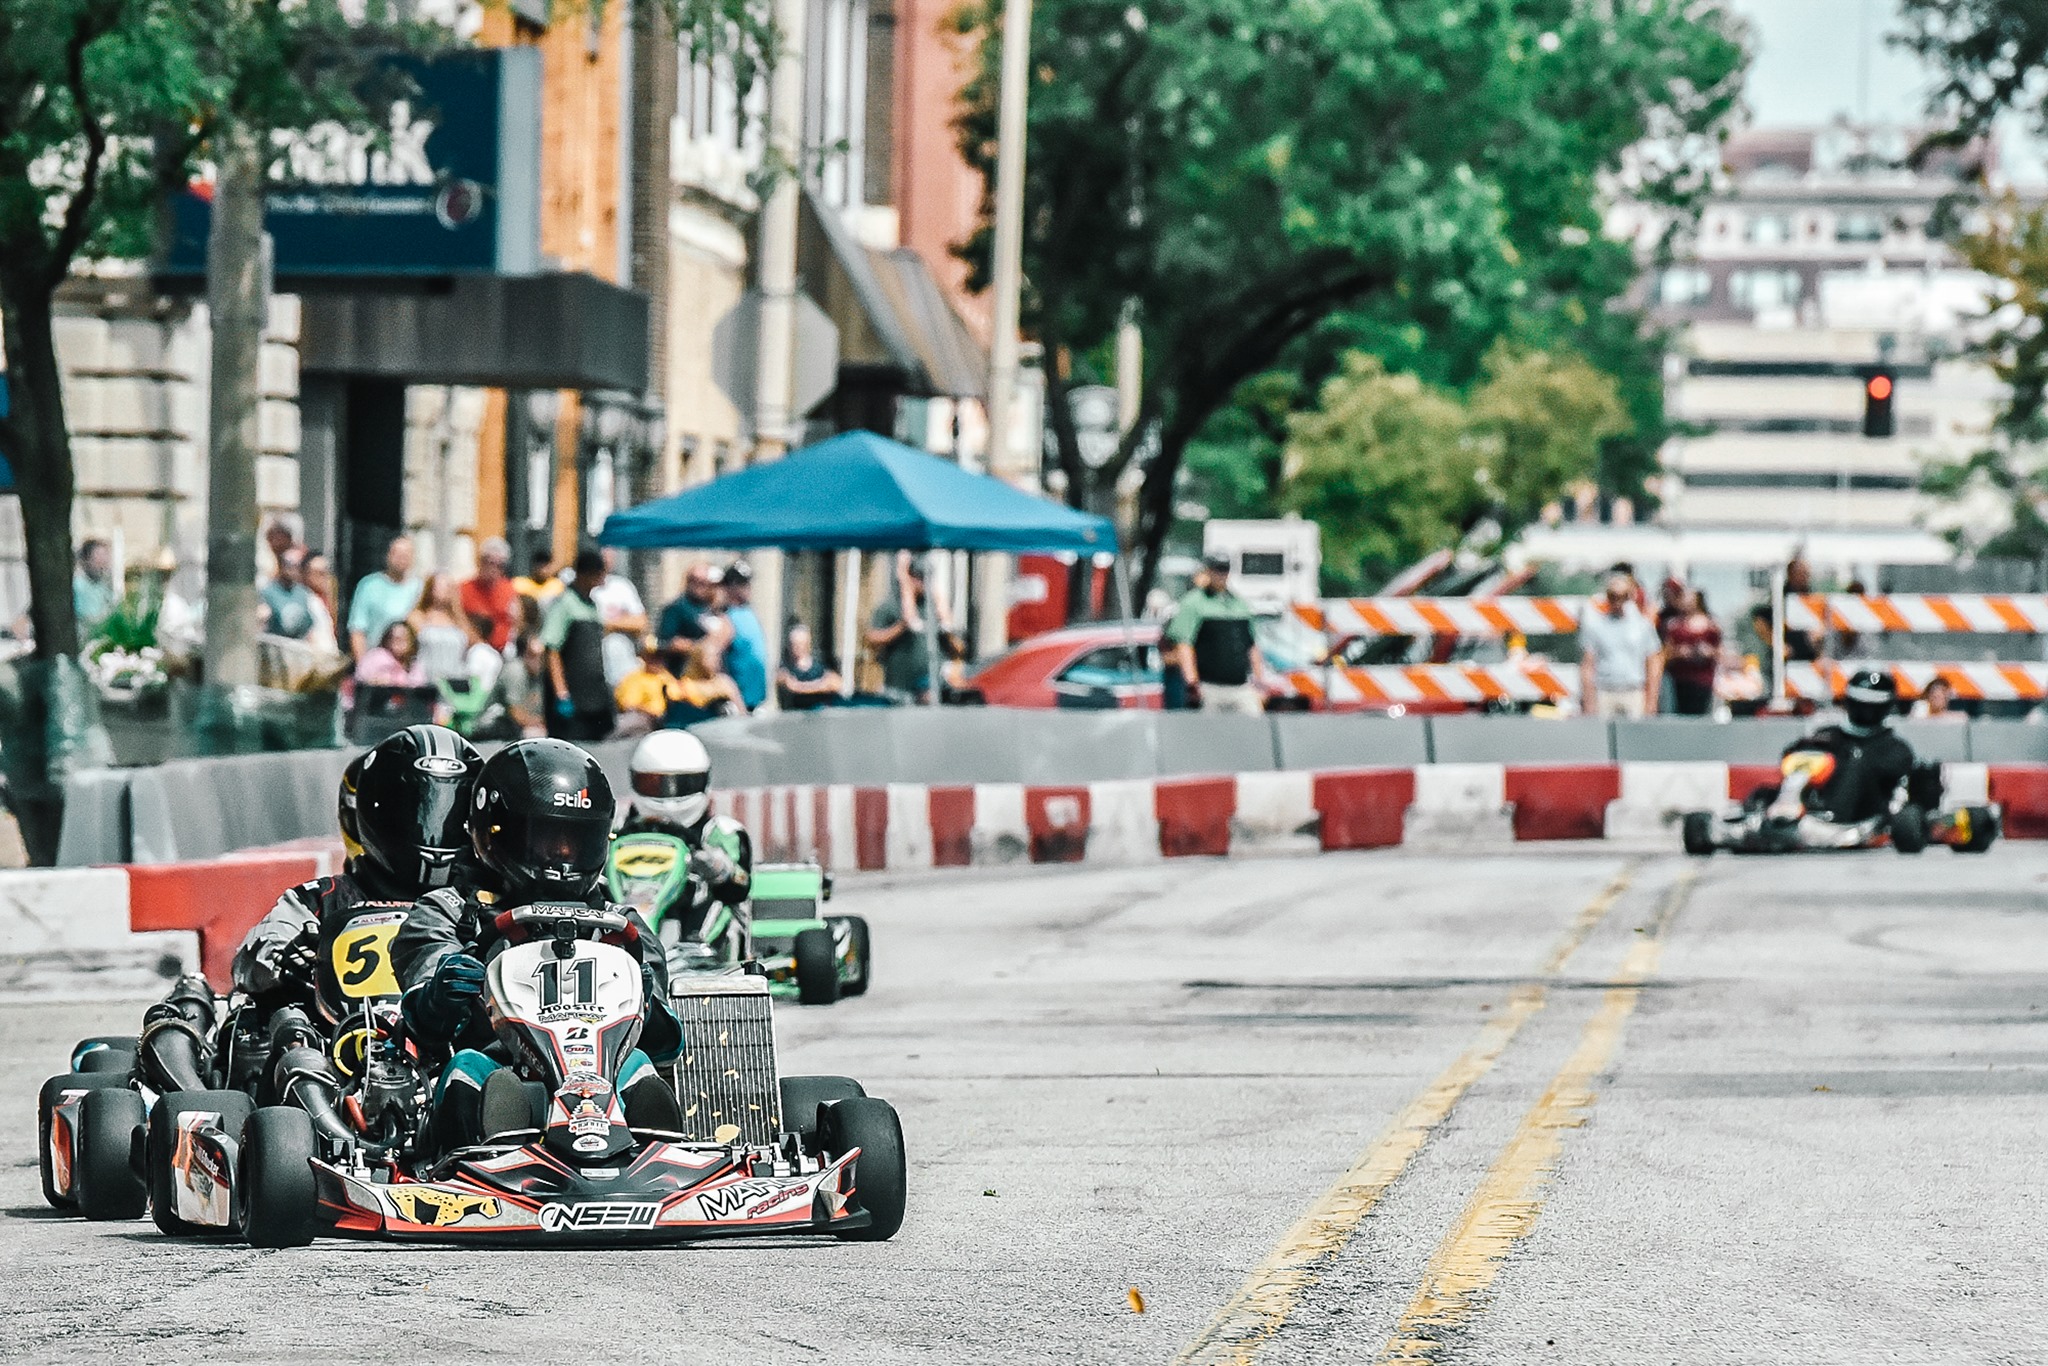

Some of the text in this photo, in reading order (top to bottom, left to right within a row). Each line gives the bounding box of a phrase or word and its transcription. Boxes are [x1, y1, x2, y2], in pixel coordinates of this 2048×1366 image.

[553, 789, 592, 809] Stilo
[531, 957, 597, 1009] 11
[746, 1182, 810, 1220] racing
